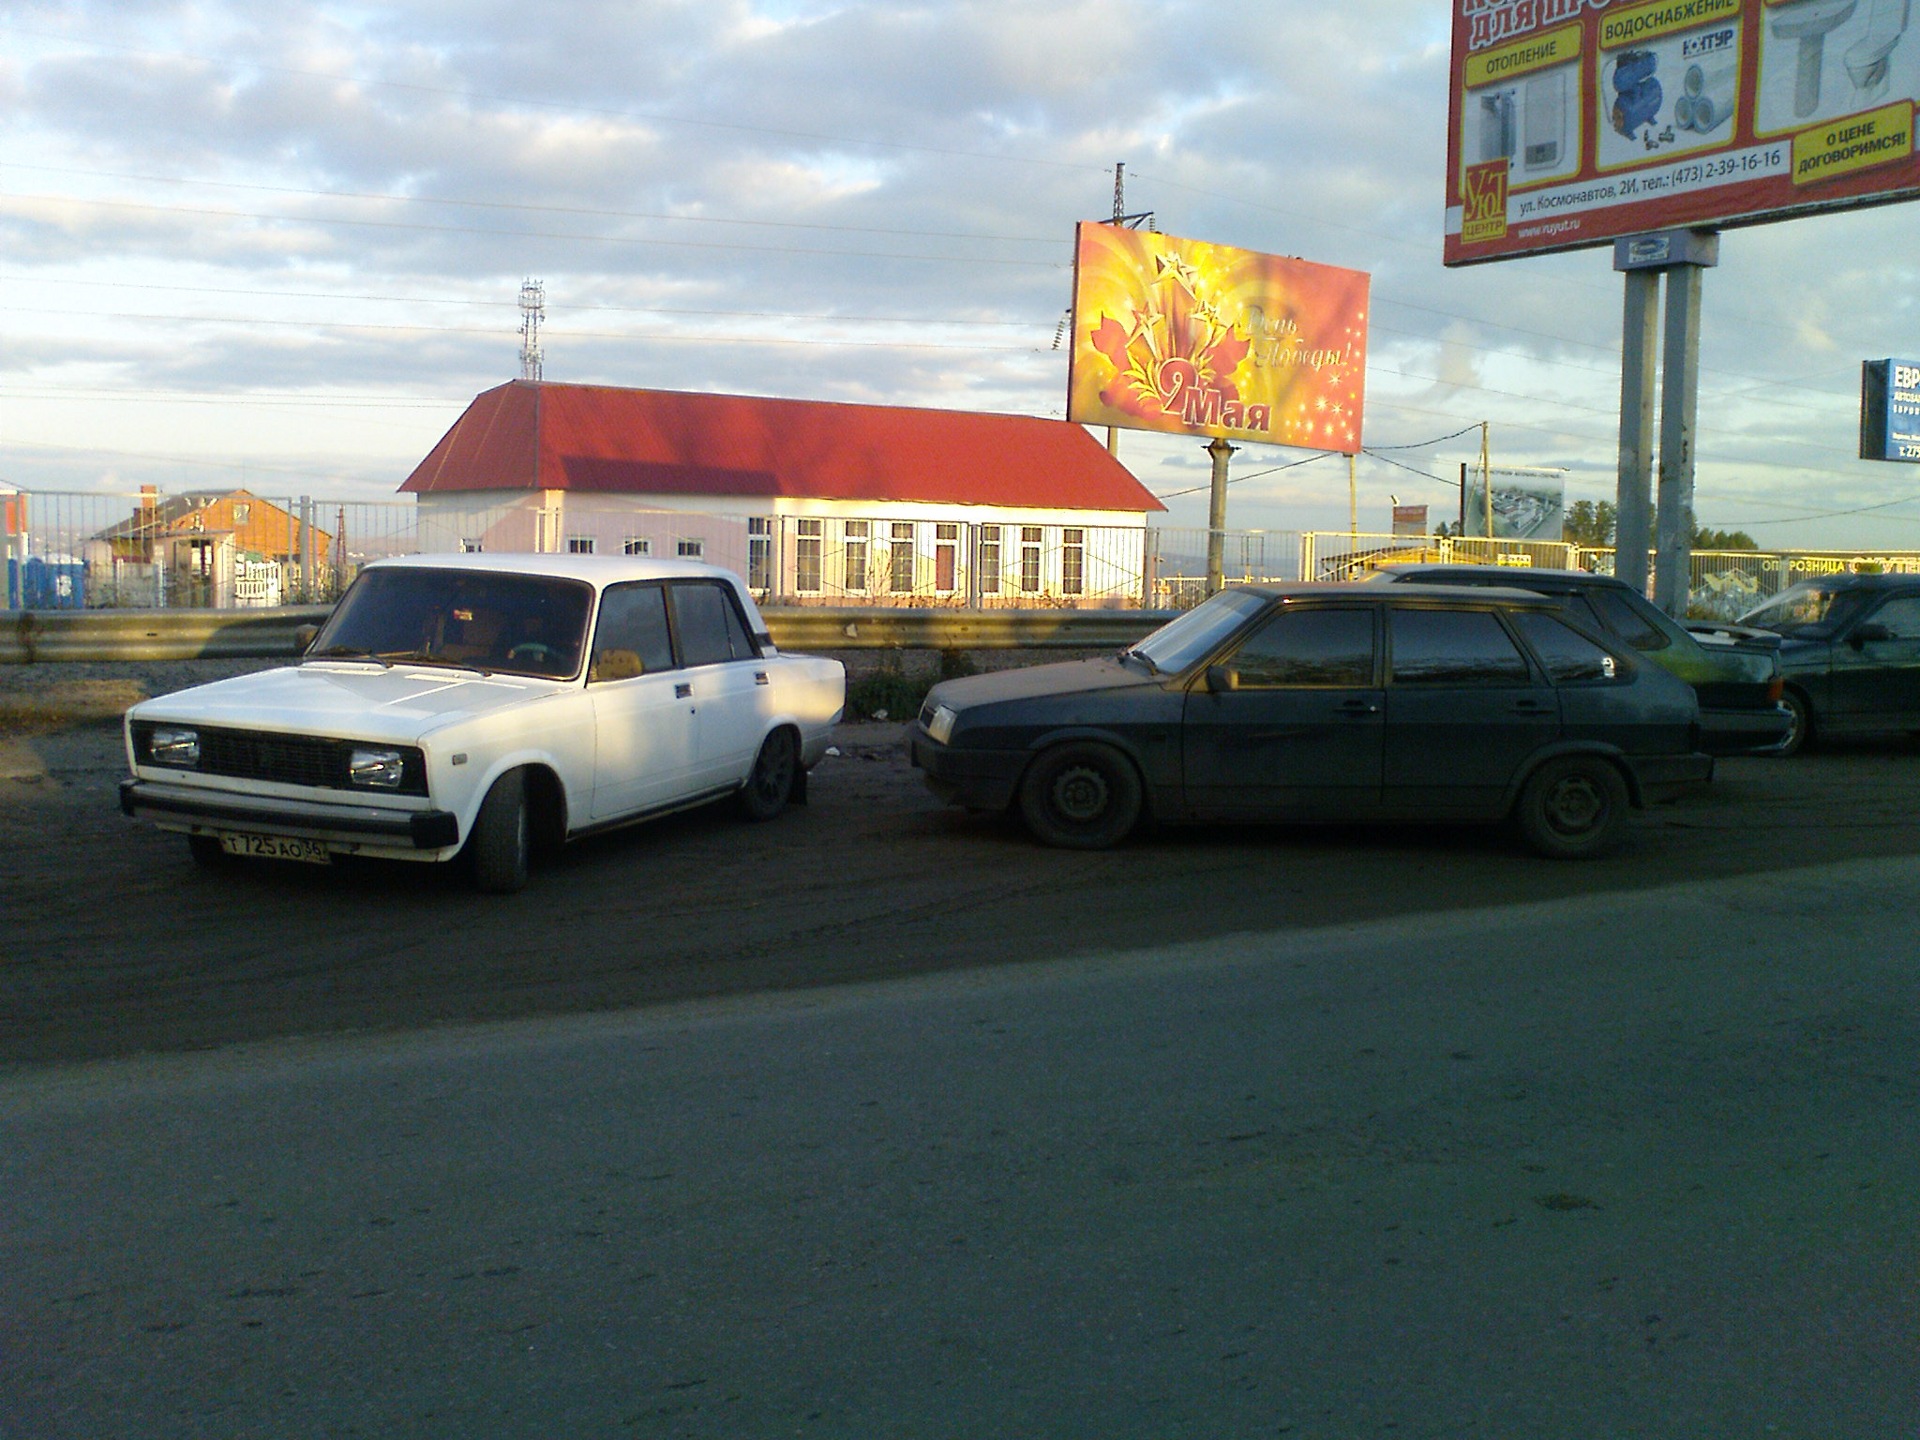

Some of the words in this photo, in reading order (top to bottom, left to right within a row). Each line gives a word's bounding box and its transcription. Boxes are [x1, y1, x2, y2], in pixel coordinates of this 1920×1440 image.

[1470, 0, 1536, 49] ДЛЯ
[1486, 40, 1557, 75] ОТОПЛЕНИЕ
[1798, 131, 1907, 175] ДОГОВОРИМСЯ!
[1826, 132, 1837, 146] О
[1839, 121, 1876, 143] ЦЕНЕ
[1519, 202, 1536, 217] ул.
[1537, 186, 1616, 211] Космонавтов,
[1671, 165, 1703, 187] (473)
[1705, 149, 1781, 178] 2-39-16-16
[1465, 219, 1503, 237] ЦЕНТР
[1157, 357, 1199, 415] 9
[1182, 386, 1273, 434] Мая
[1761, 560, 1780, 572] ОП
[1789, 559, 1845, 574] РОЗНИЦА
